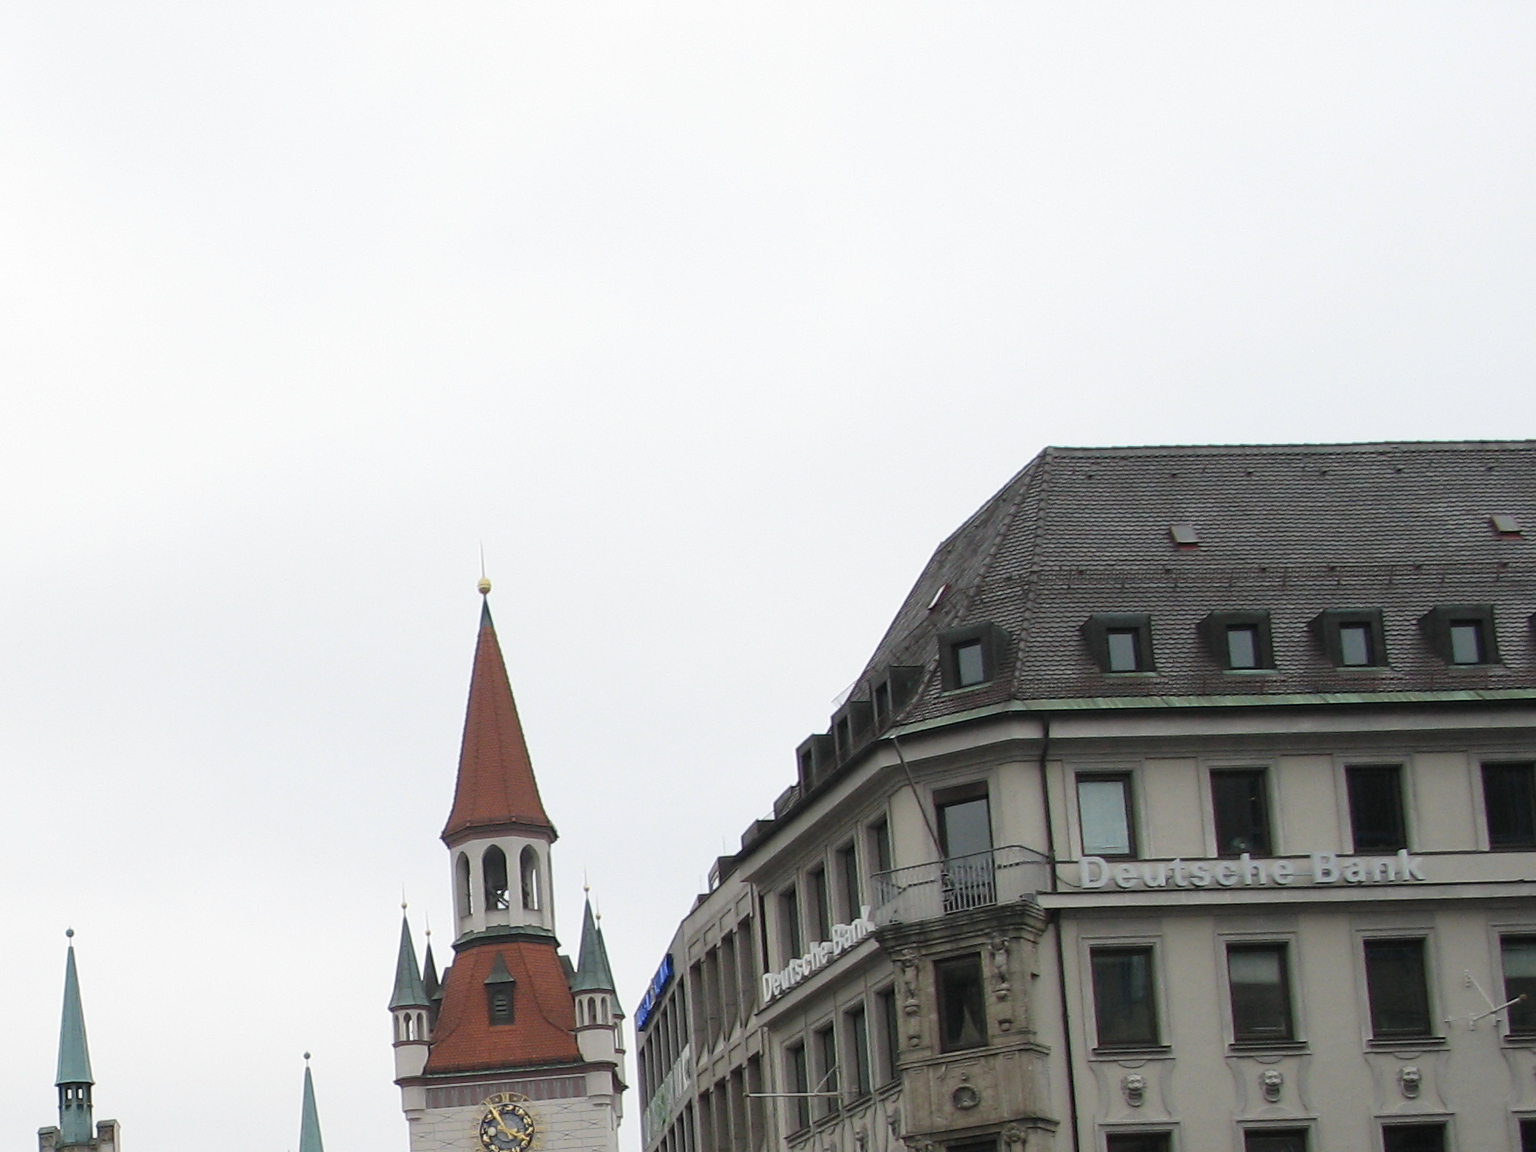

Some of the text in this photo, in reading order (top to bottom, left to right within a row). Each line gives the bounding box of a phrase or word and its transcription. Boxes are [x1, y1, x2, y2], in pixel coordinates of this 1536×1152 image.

[1079, 848, 1426, 889] Deutsche Bank
[762, 905, 876, 1004] Deutsche Bank
